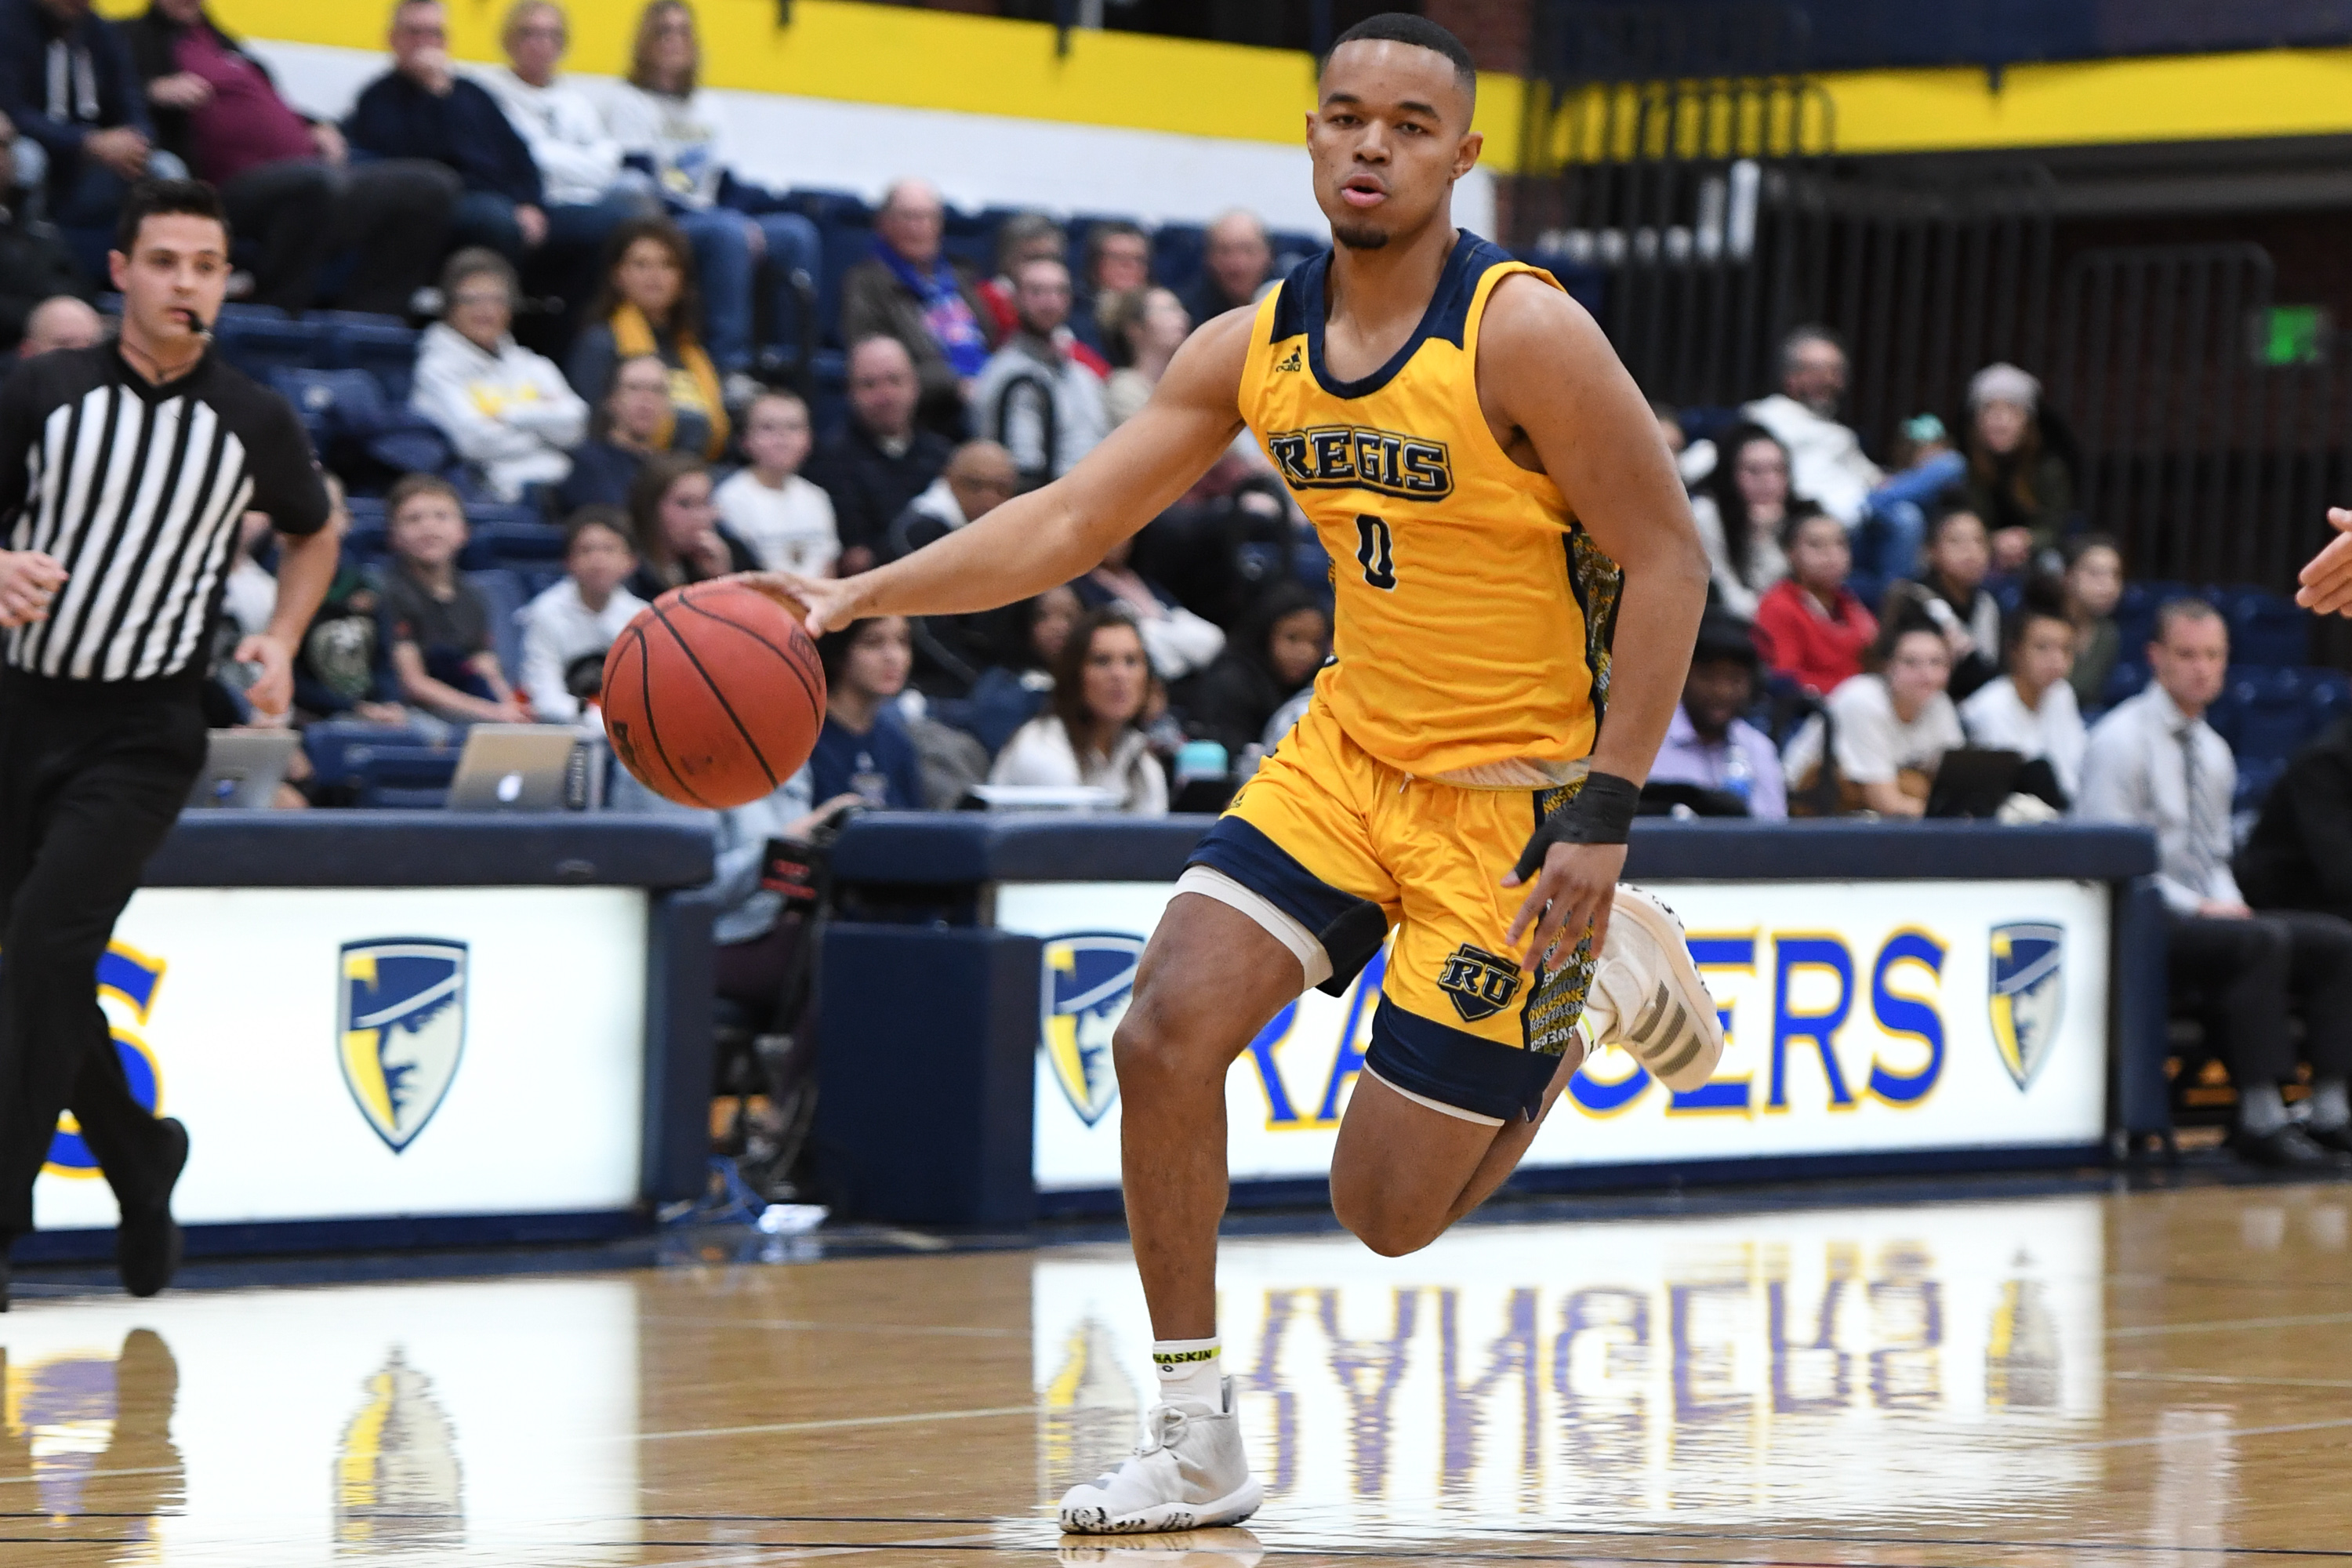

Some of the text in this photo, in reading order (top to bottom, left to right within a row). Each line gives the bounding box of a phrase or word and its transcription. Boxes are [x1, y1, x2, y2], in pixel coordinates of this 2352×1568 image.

[1266, 425, 1454, 499] REGIS
[1356, 514, 1398, 591] 0
[1438, 953, 1522, 1009] RU
